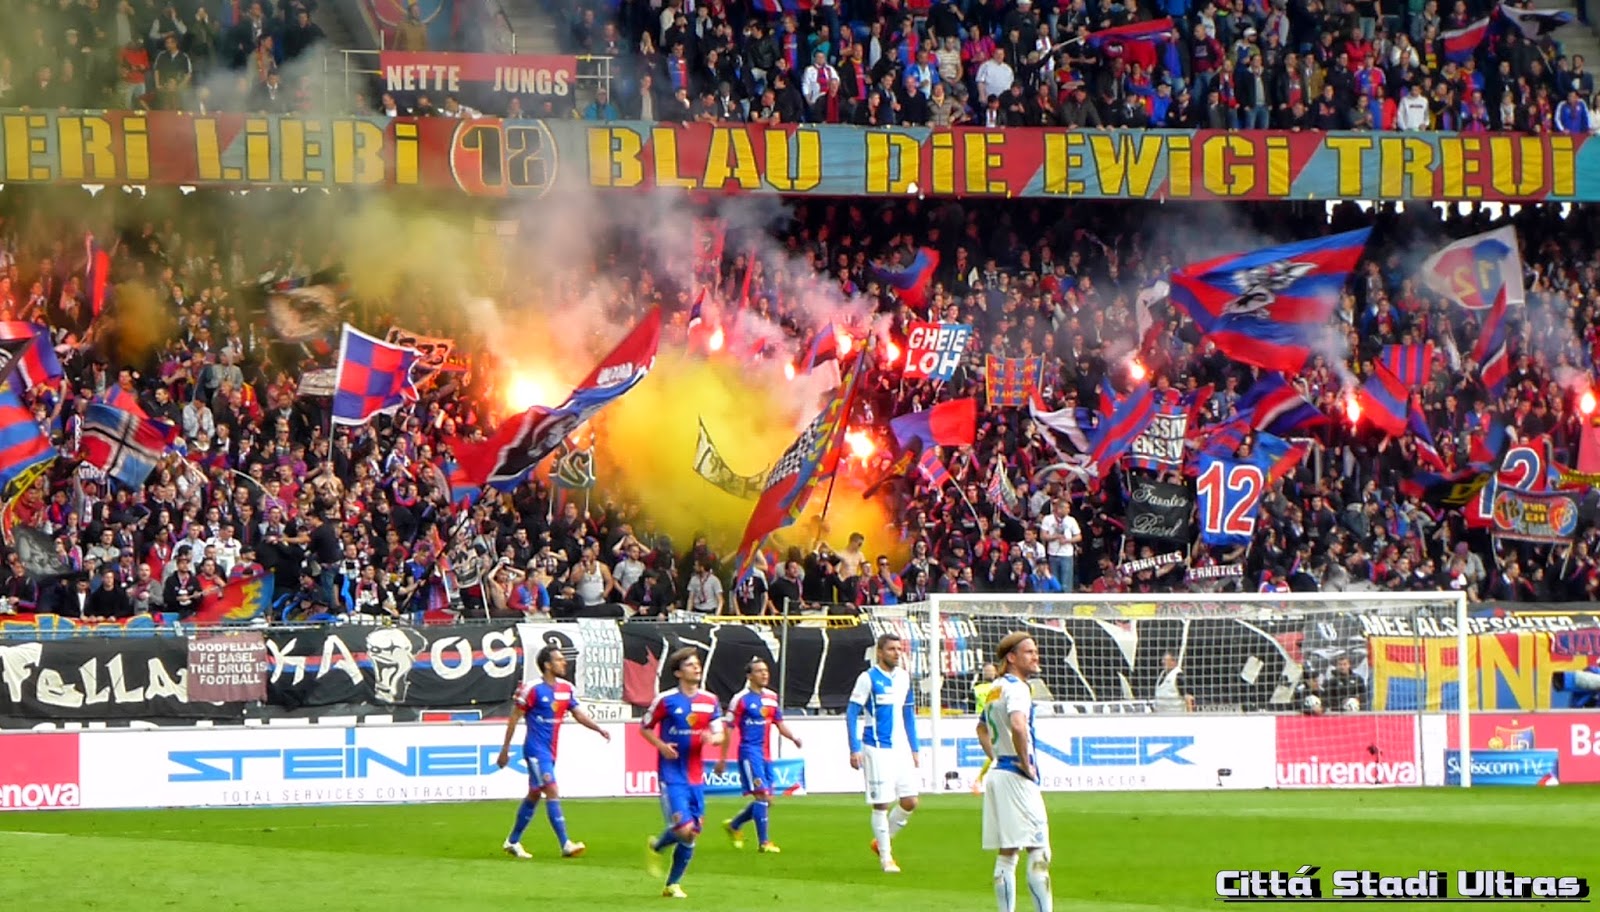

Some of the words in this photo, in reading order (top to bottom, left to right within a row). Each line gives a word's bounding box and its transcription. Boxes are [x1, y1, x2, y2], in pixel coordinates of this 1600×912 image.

[387, 65, 461, 92] NETTE
[494, 66, 570, 96] JUNGS
[586, 127, 822, 190] BLAU
[904, 351, 962, 376] LOH
[1196, 460, 1265, 536] 12
[1123, 550, 1183, 574] FANATICS
[1358, 614, 1414, 636] MEE
[1416, 617, 1460, 636] ALS
[188, 641, 265, 652] GOODFELLAS
[200, 652, 216, 663] FC
[218, 652, 257, 664] BASEL
[189, 663, 215, 674] THE
[217, 663, 253, 674] DRUG
[255, 661, 268, 672] IS
[199, 673, 262, 685] FOOTBALL
[1276, 756, 1416, 784] unirenova
[222, 791, 272, 803] TOTAL
[282, 787, 365, 801] SERVICES
[376, 785, 489, 799] CONTRACTOR
